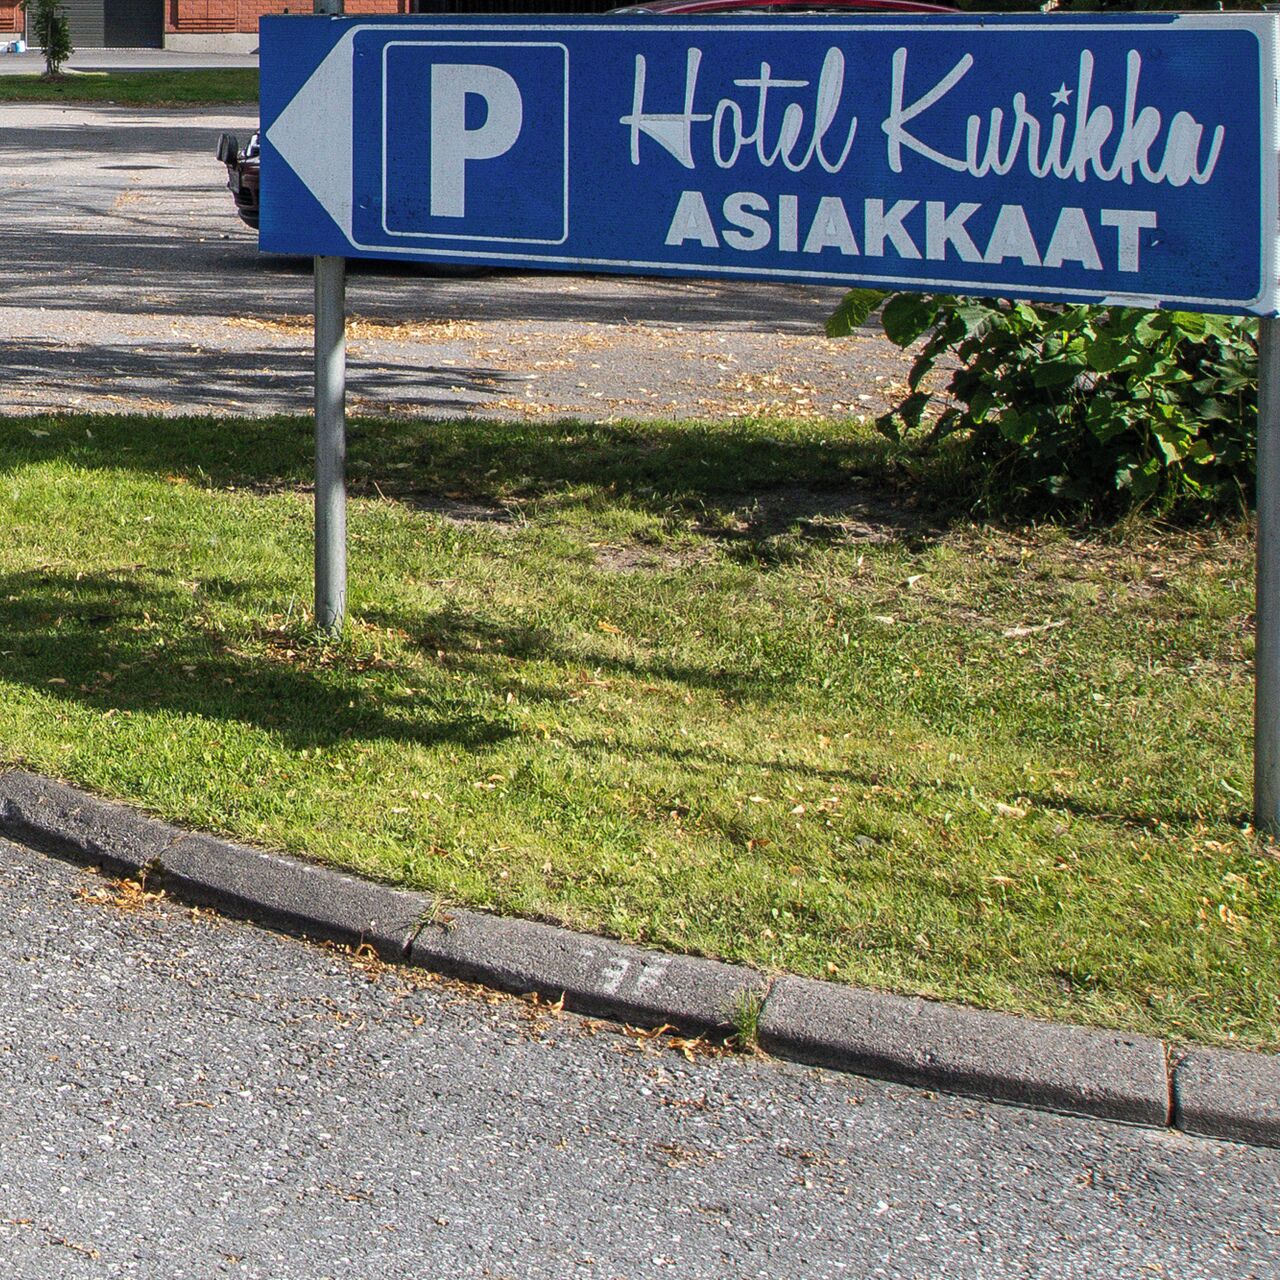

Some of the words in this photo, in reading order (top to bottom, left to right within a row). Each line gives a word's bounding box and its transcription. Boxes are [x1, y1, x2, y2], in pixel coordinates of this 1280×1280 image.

[430, 63, 523, 218] P
[619, 46, 858, 174] Hotel
[881, 47, 1225, 187] Kurikka
[664, 190, 1157, 274] ASIAKKAAT
